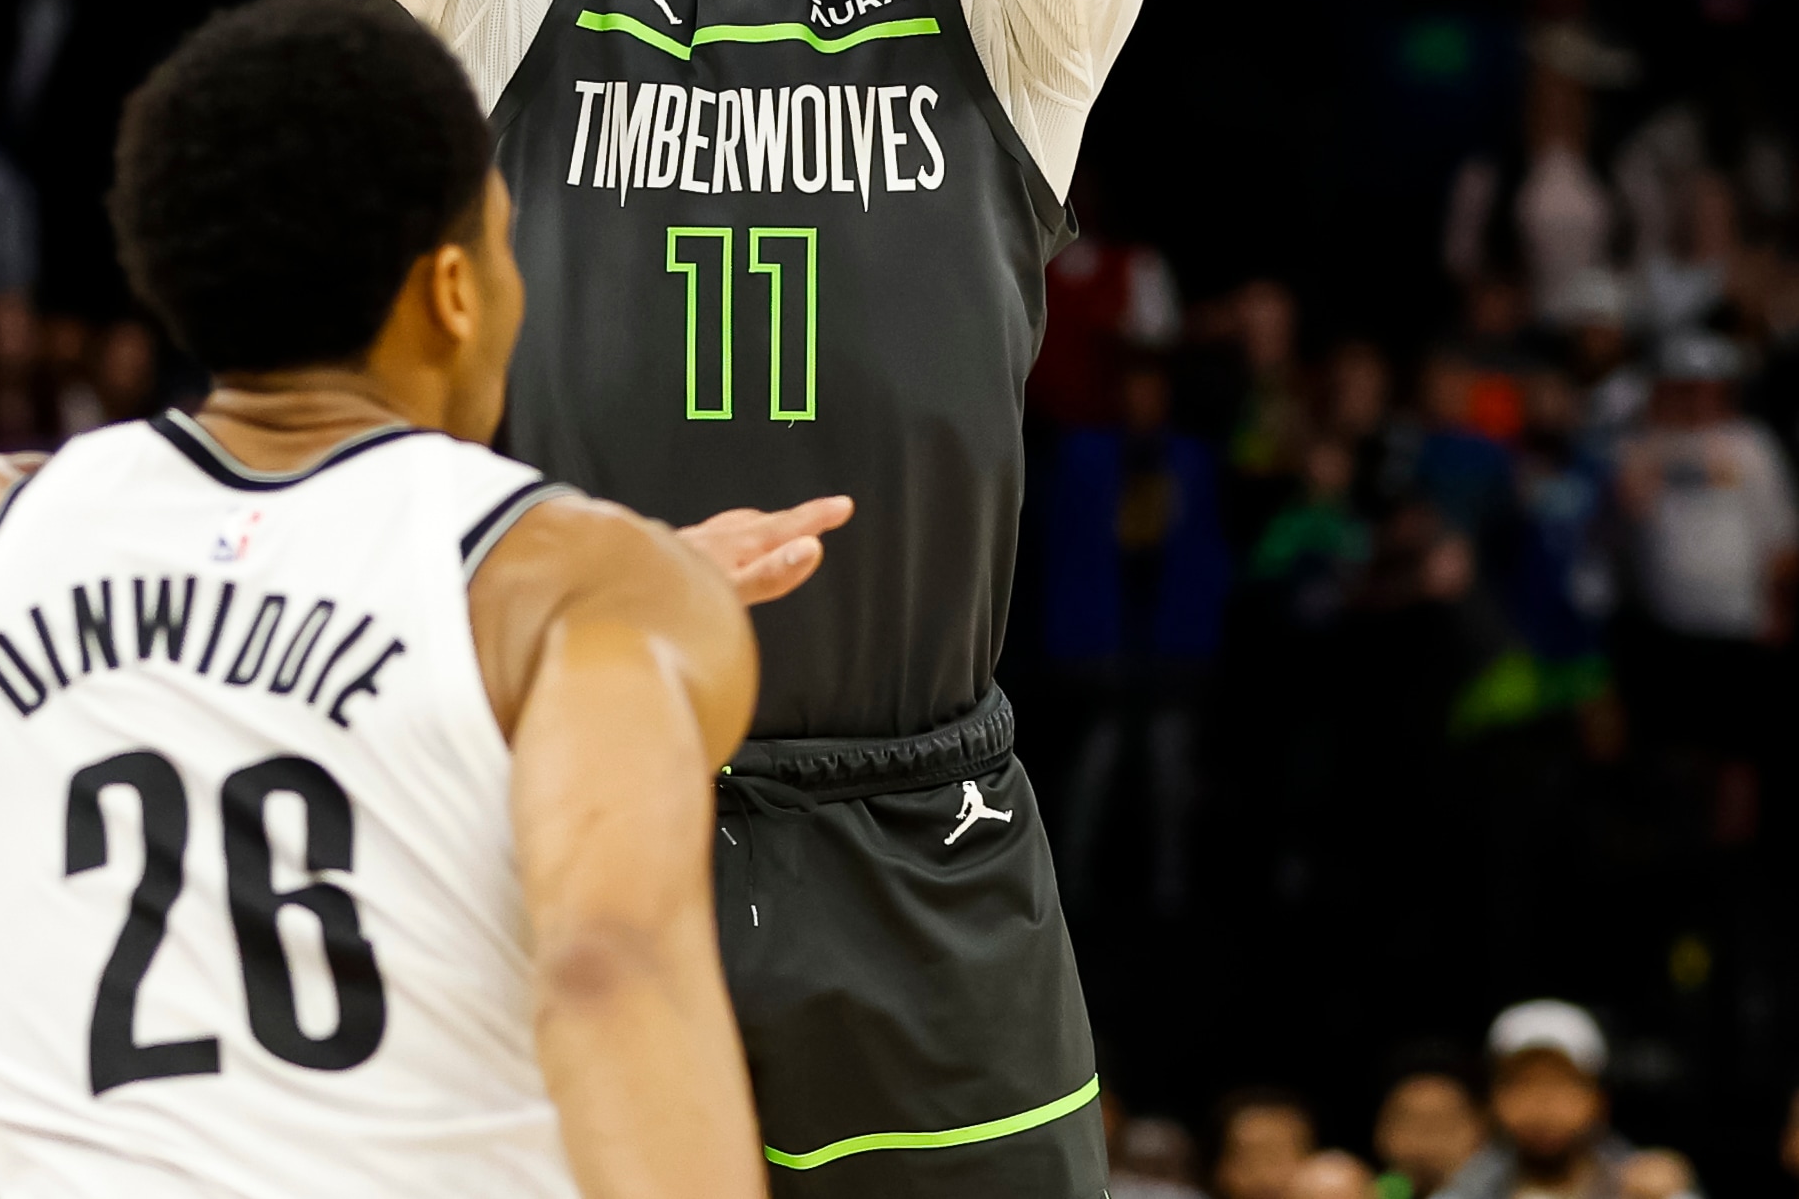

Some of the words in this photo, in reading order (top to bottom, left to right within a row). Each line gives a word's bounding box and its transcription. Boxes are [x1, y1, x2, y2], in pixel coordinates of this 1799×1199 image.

[566, 80, 945, 212] TIMBERWOLVES
[665, 226, 818, 421] 11
[65, 750, 387, 1097] 26
